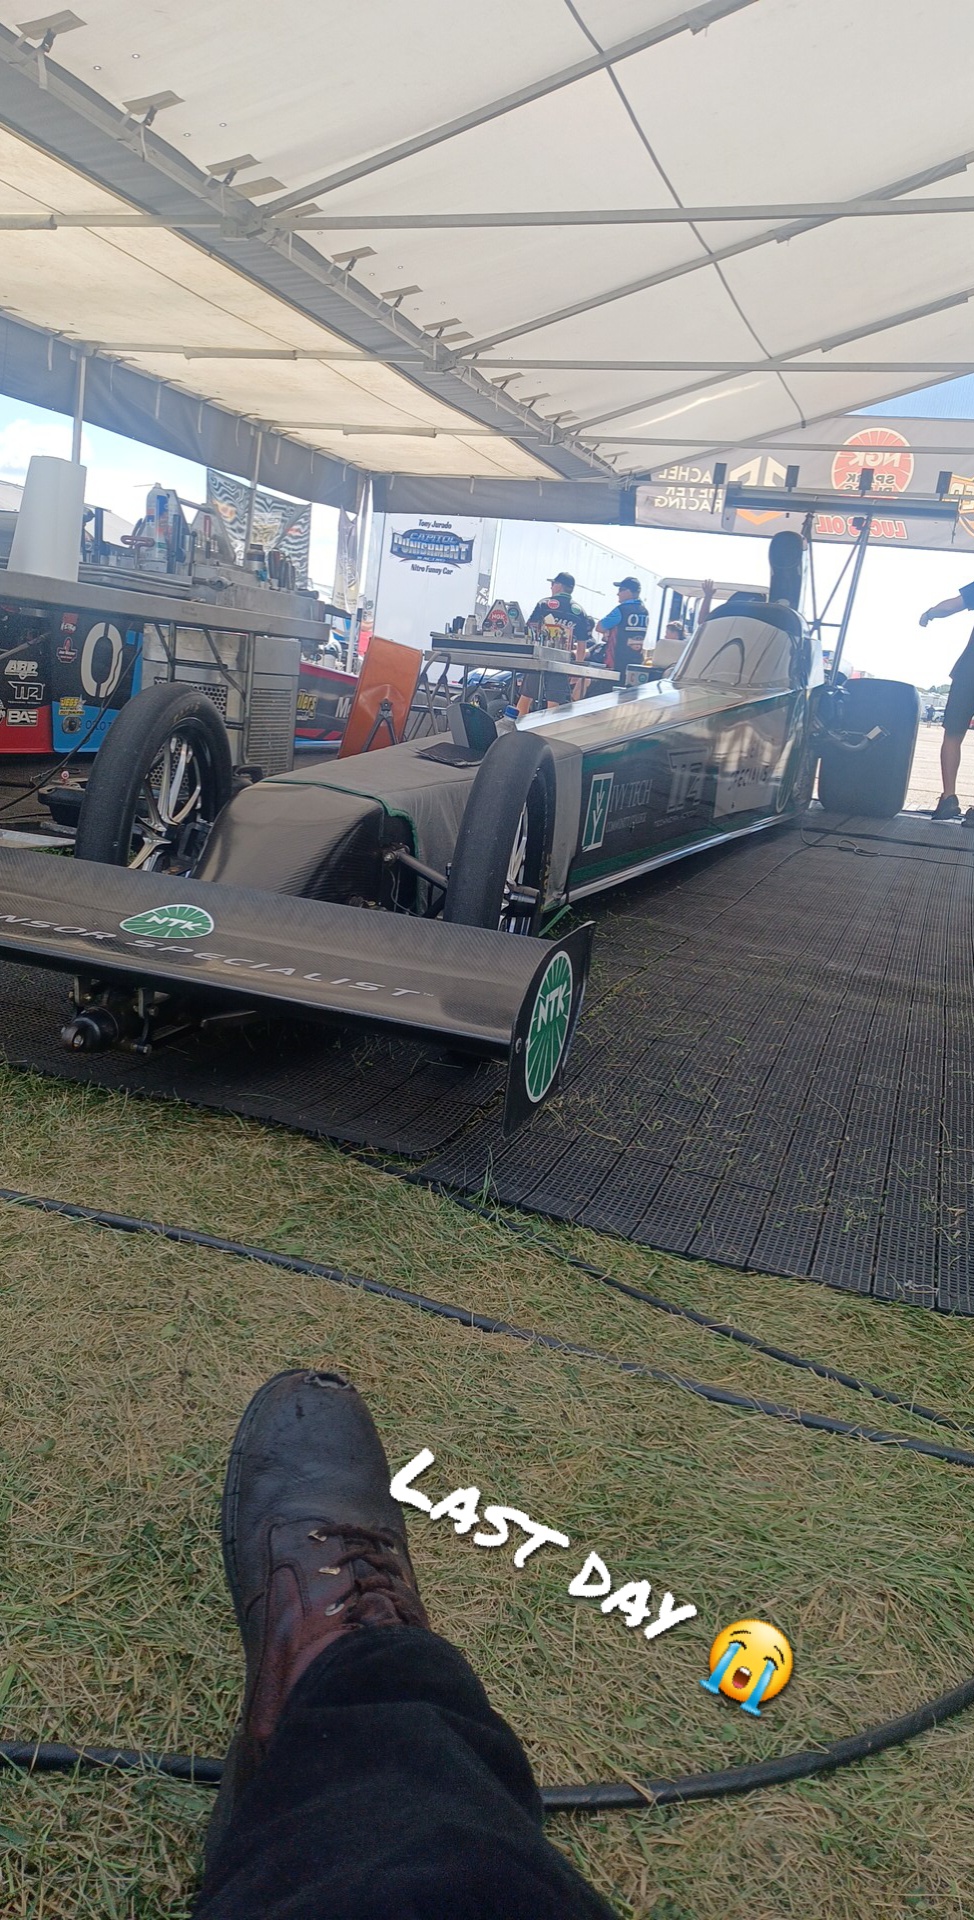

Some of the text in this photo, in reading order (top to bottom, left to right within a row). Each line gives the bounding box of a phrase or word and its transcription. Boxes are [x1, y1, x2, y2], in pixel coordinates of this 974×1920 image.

[418, 519, 452, 529] Tony Jurado
[410, 532, 458, 544] CAPITOL
[393, 534, 469, 560] PUNISHMENT
[411, 564, 453, 575] Nitro Funny Car
[5, 660, 38, 674] ARP
[8, 711, 37, 723] BAE
[144, 915, 203, 931] NTK
[536, 980, 567, 1033] NTK
